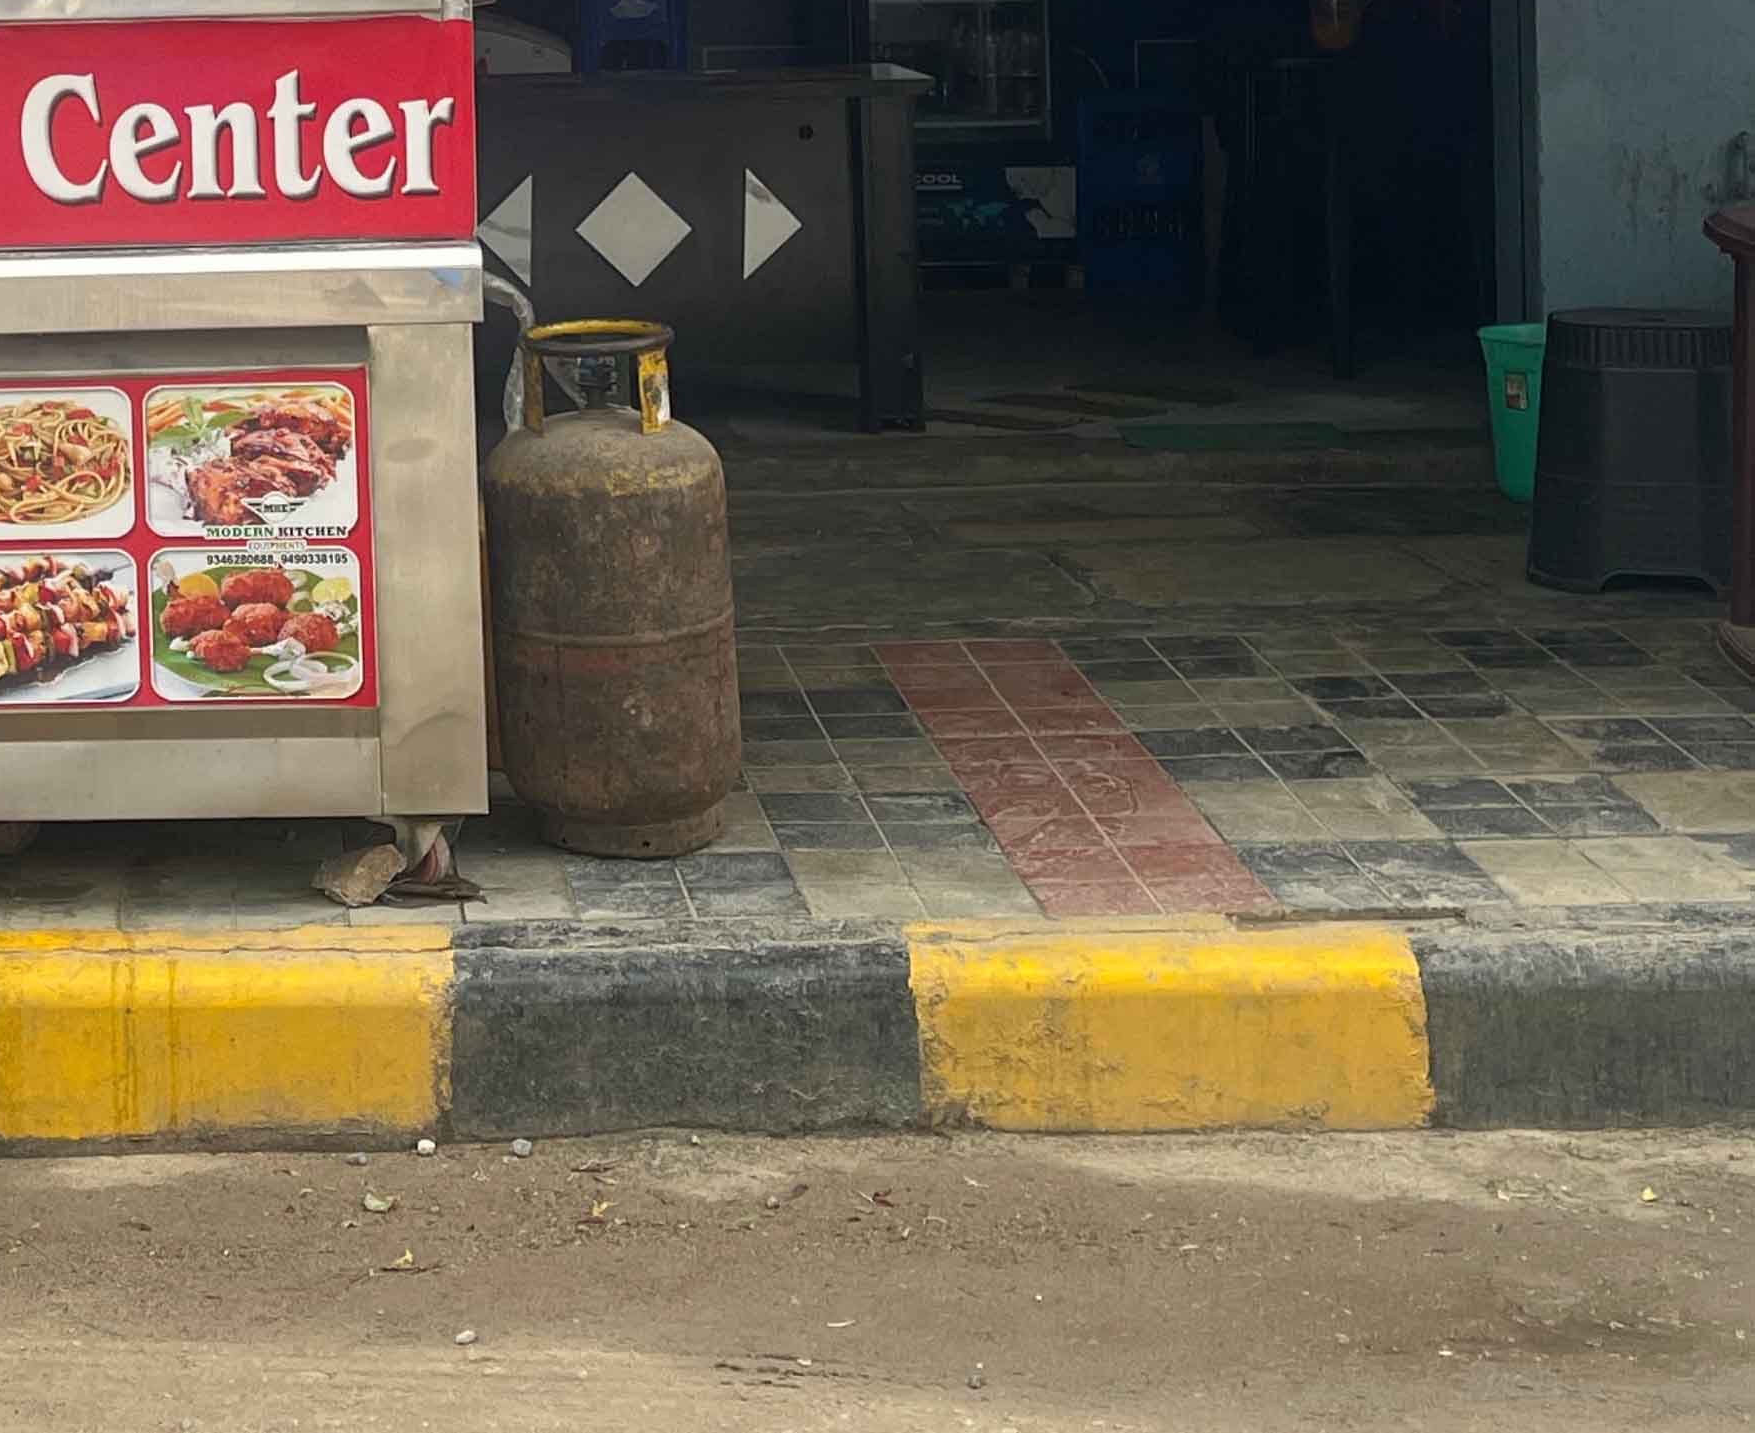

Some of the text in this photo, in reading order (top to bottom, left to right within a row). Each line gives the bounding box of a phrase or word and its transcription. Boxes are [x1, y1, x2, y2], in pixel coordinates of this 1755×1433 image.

[19, 68, 456, 204] Center
[206, 525, 347, 538] MODERN KITCHEN
